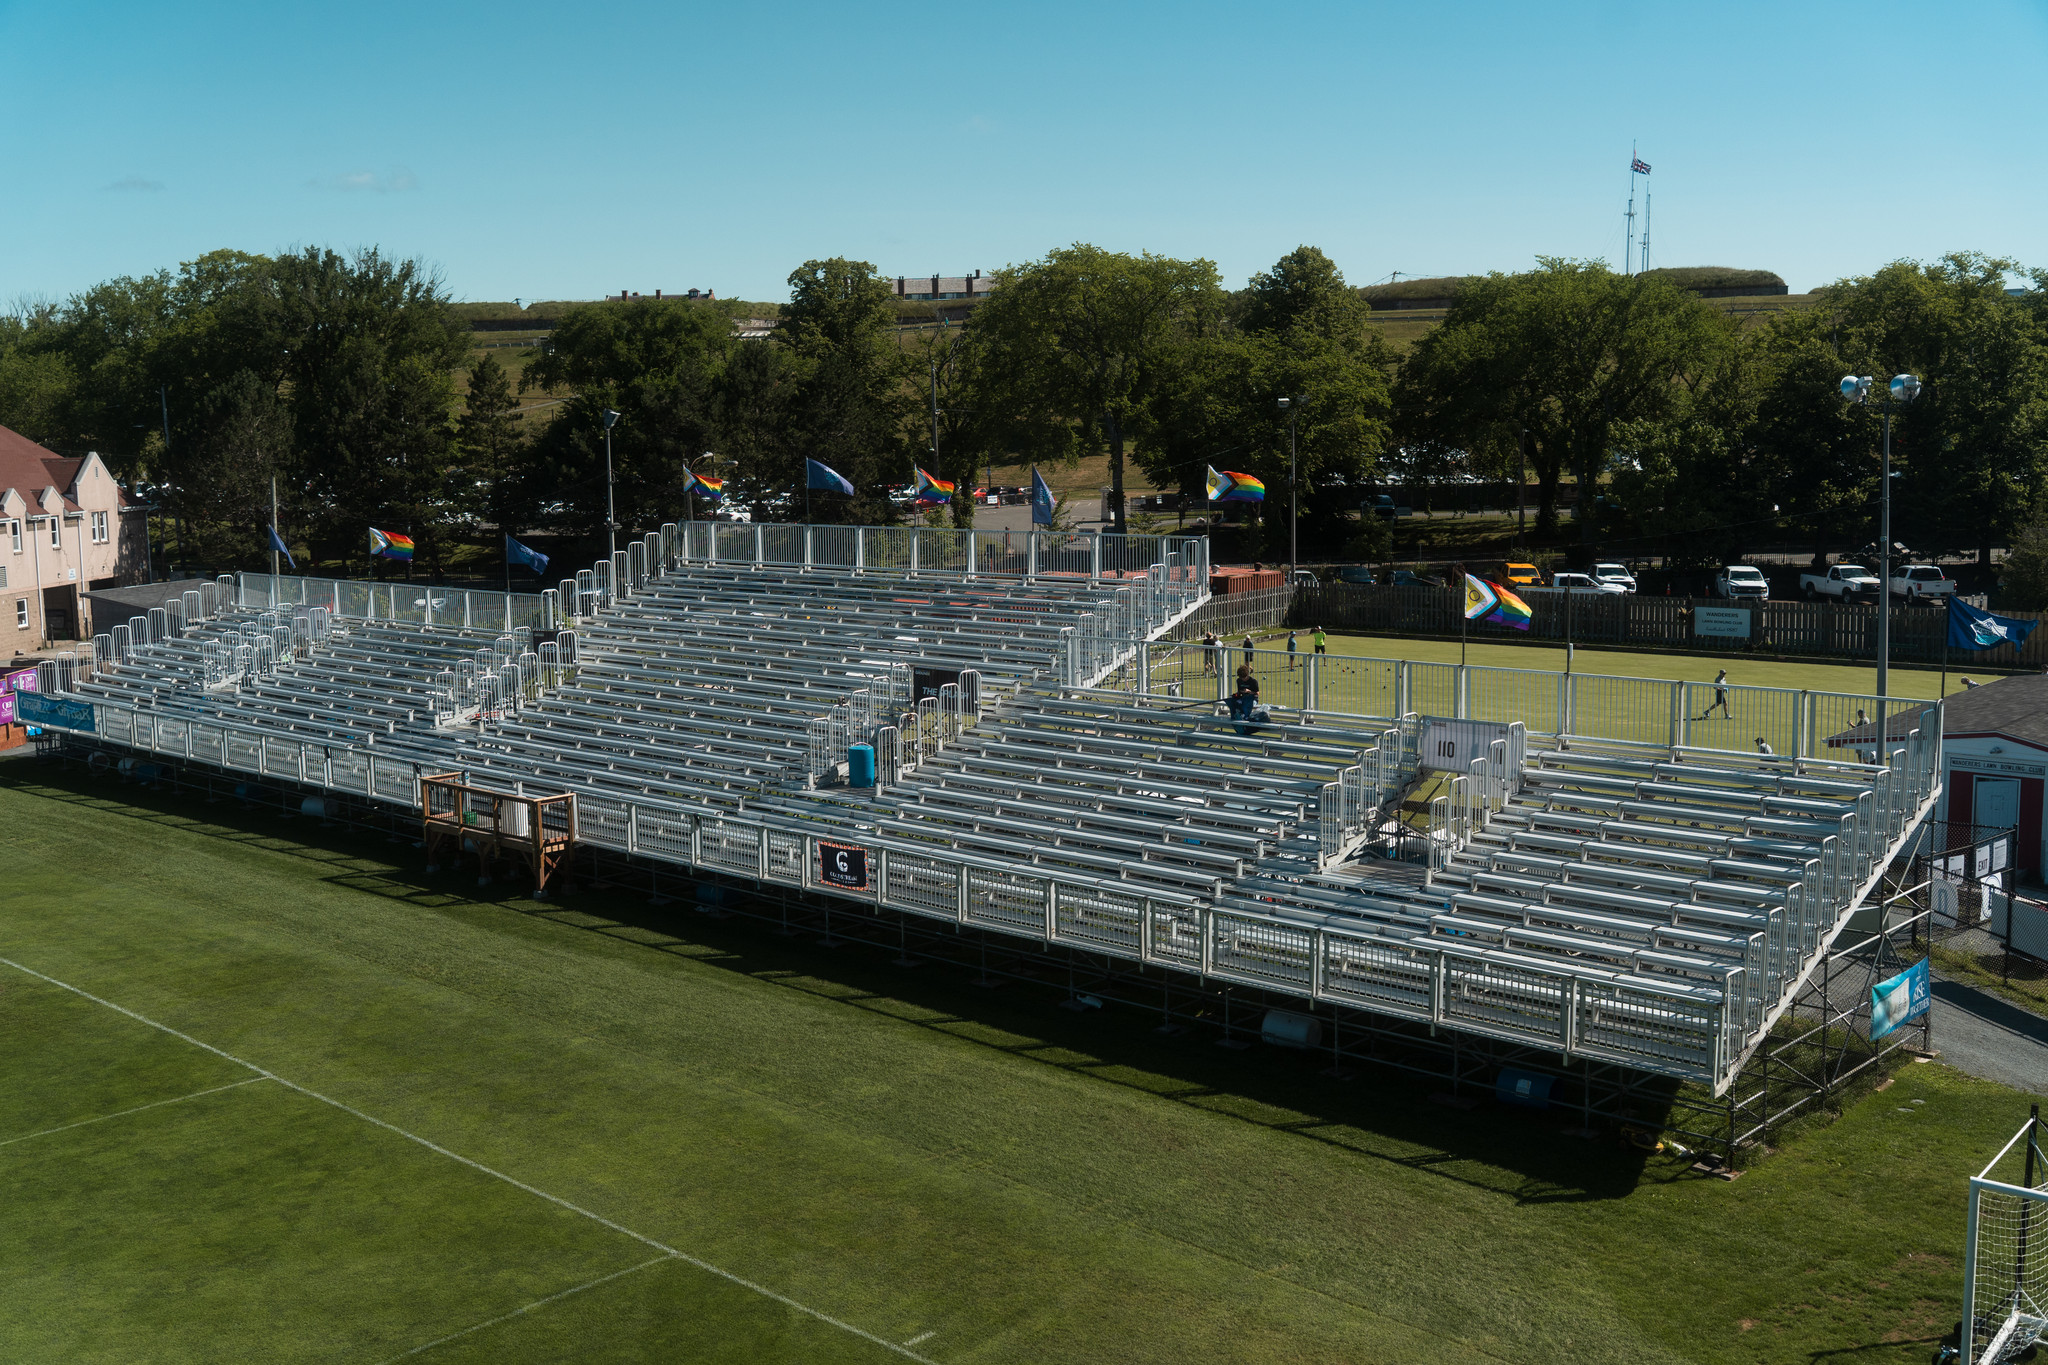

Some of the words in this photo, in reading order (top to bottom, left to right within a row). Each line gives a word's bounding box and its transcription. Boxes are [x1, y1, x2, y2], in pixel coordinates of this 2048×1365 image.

[922, 687, 937, 696] THE
[1438, 740, 1455, 758] 110
[1952, 760, 1981, 768] WANDERERS
[2000, 764, 2025, 772] BOWLING
[2028, 766, 2043, 774] CLUB
[1978, 858, 1988, 872] EXIT
[1910, 997, 1930, 1016] TOGETHER
